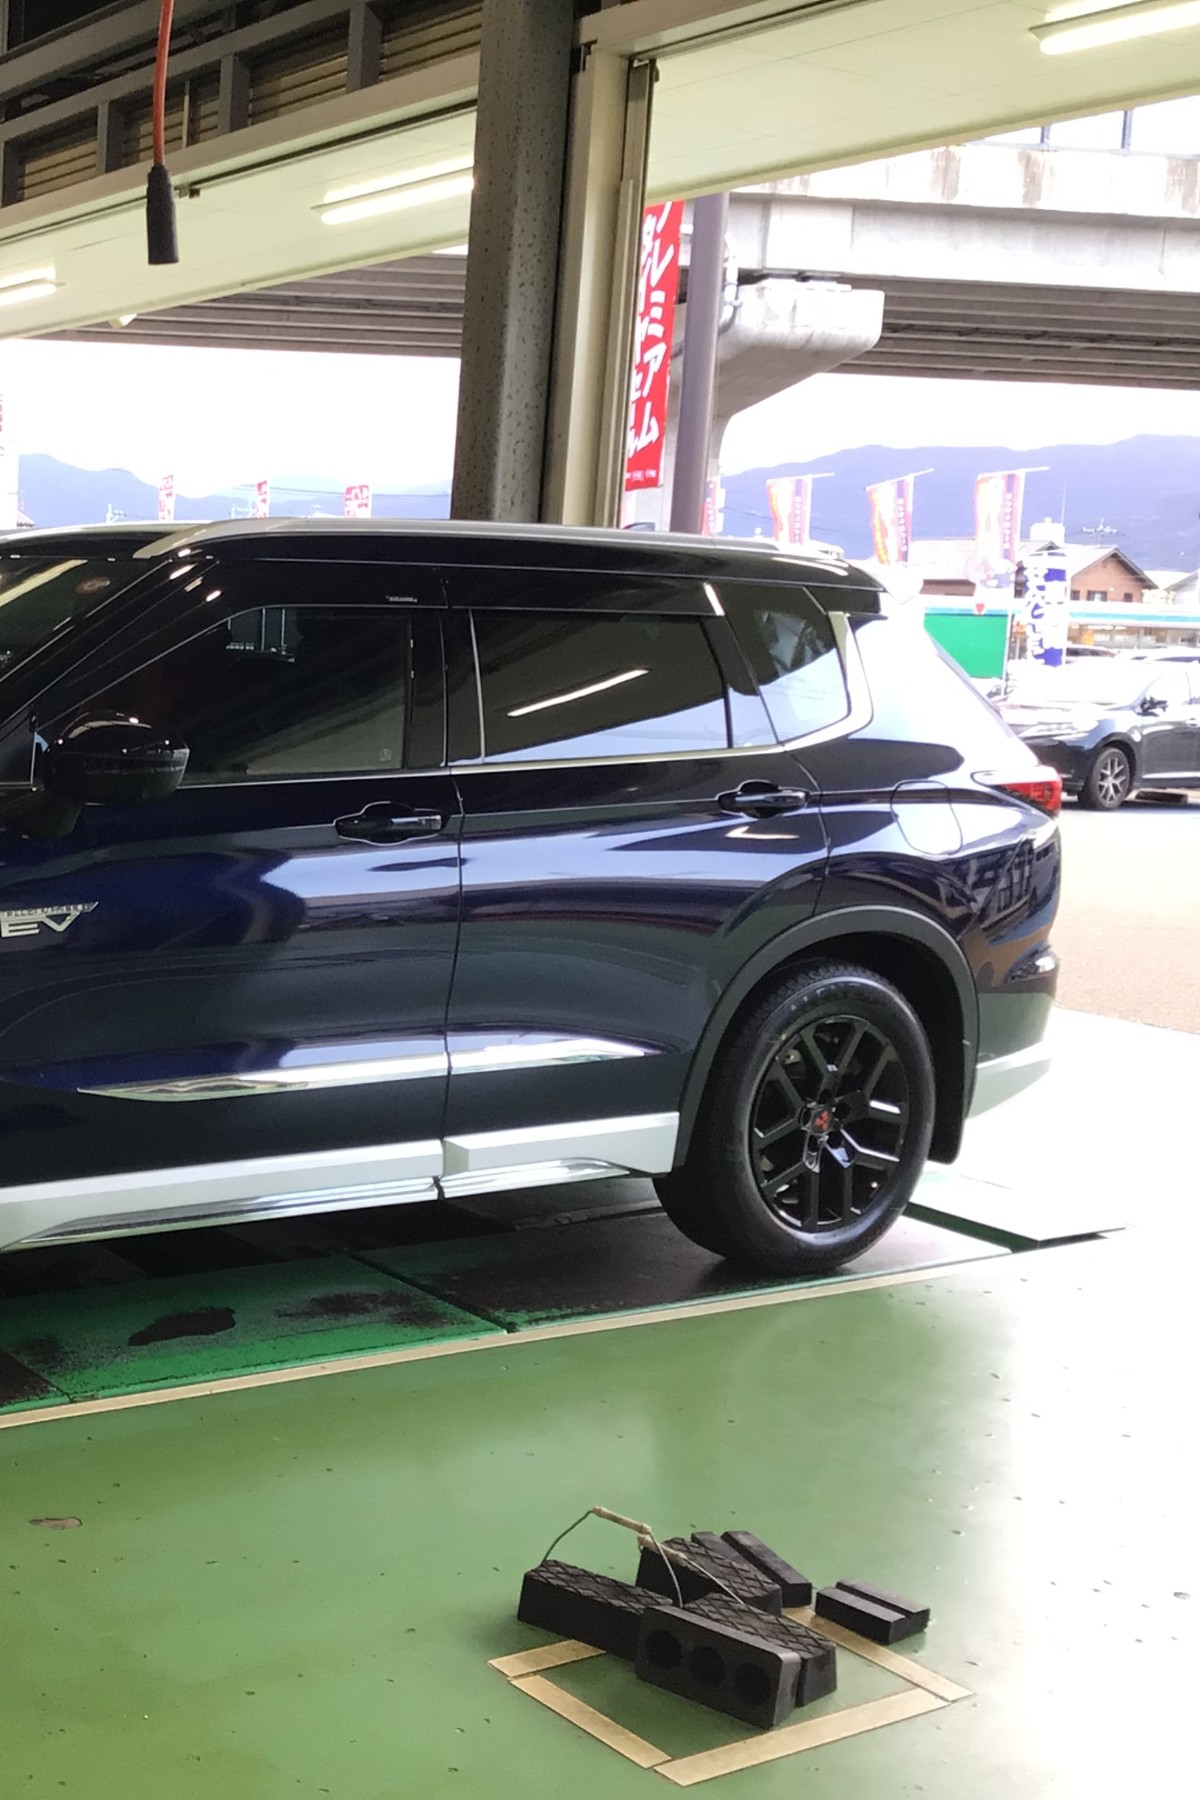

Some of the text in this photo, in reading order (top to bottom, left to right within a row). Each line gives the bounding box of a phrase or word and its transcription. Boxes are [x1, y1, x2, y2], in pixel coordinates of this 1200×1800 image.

[636, 201, 675, 453] レミアム
[0, 909, 84, 938] EV
